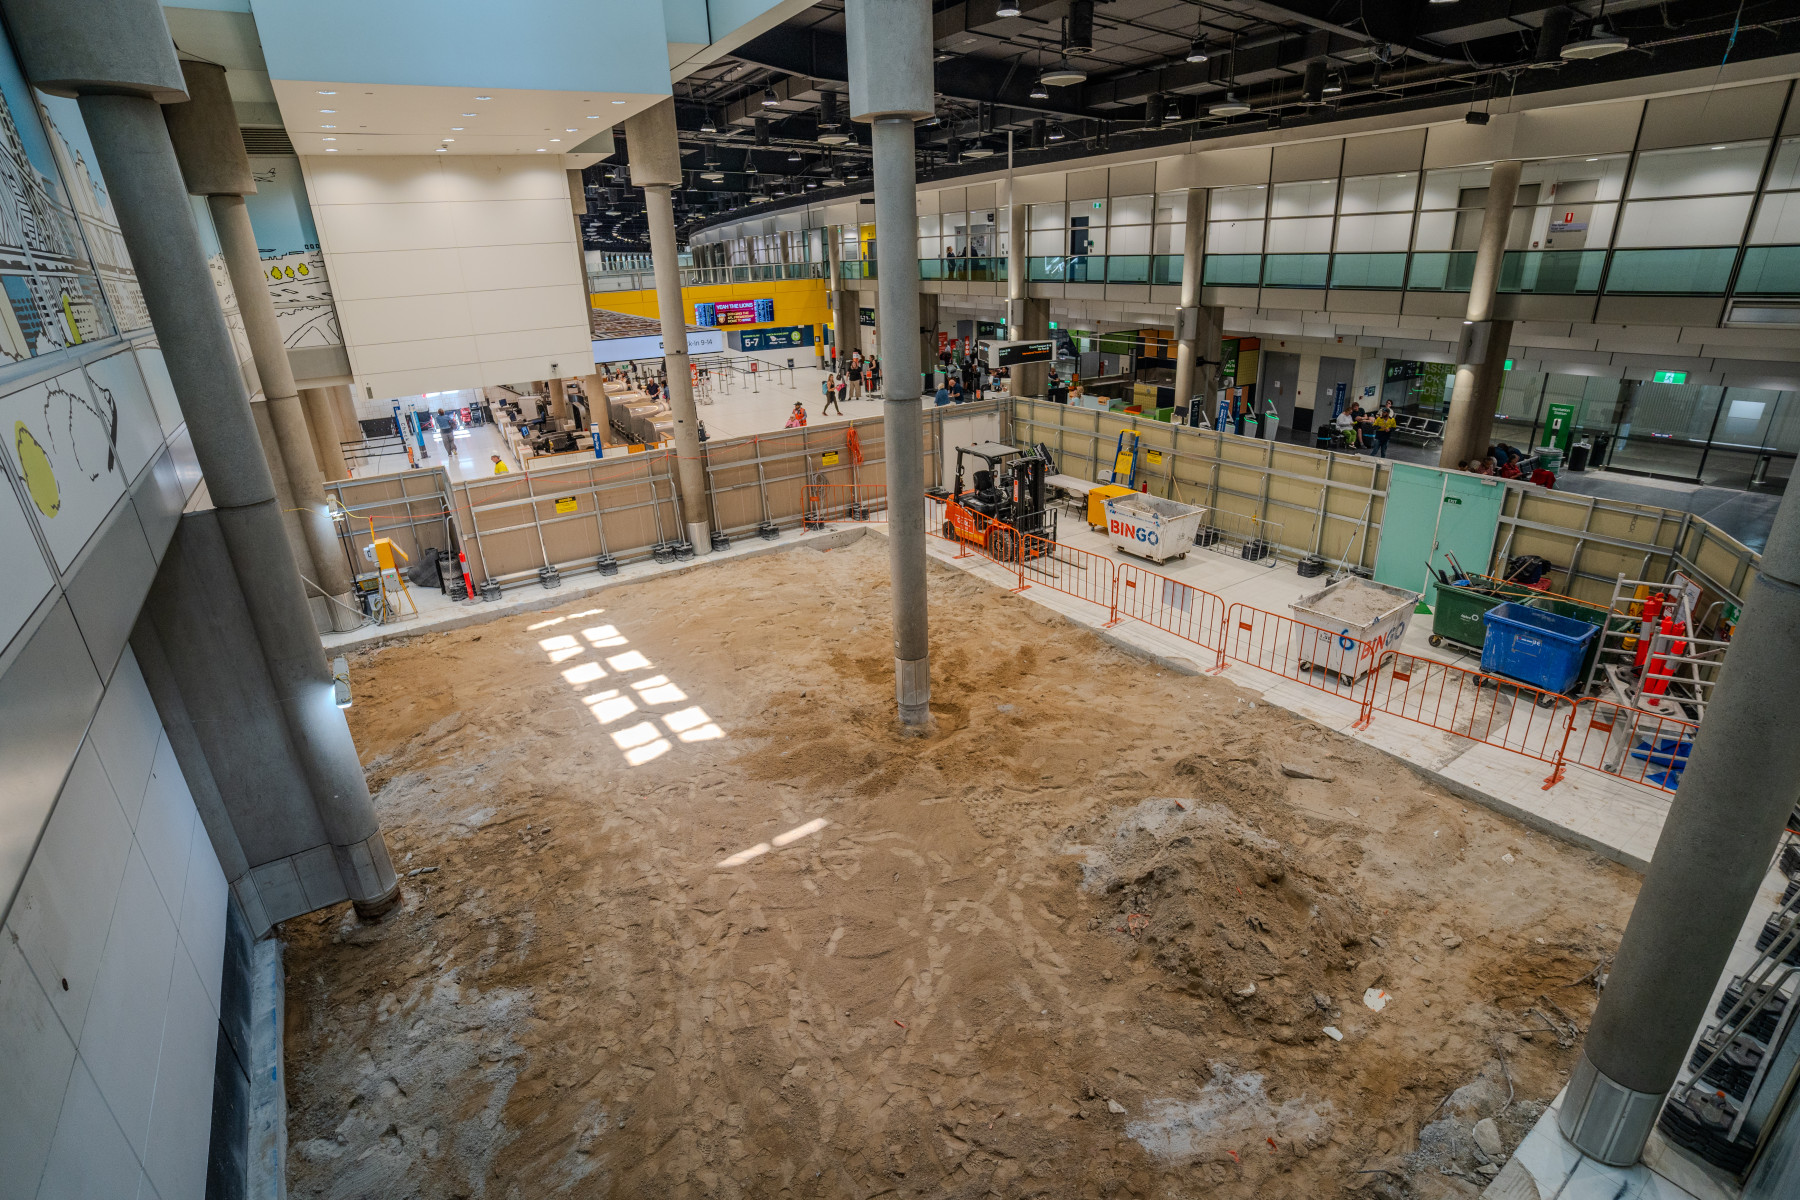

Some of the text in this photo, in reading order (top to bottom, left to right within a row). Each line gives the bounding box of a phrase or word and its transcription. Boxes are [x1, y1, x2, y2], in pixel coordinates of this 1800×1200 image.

[701, 338, 713, 346] 9-14
[1394, 366, 1403, 376] 5-7
[1425, 363, 1456, 374] ASSEN
[1110, 519, 1159, 546] BINGO
[1338, 628, 1355, 651] 6
[1360, 621, 1405, 661] BINGO
